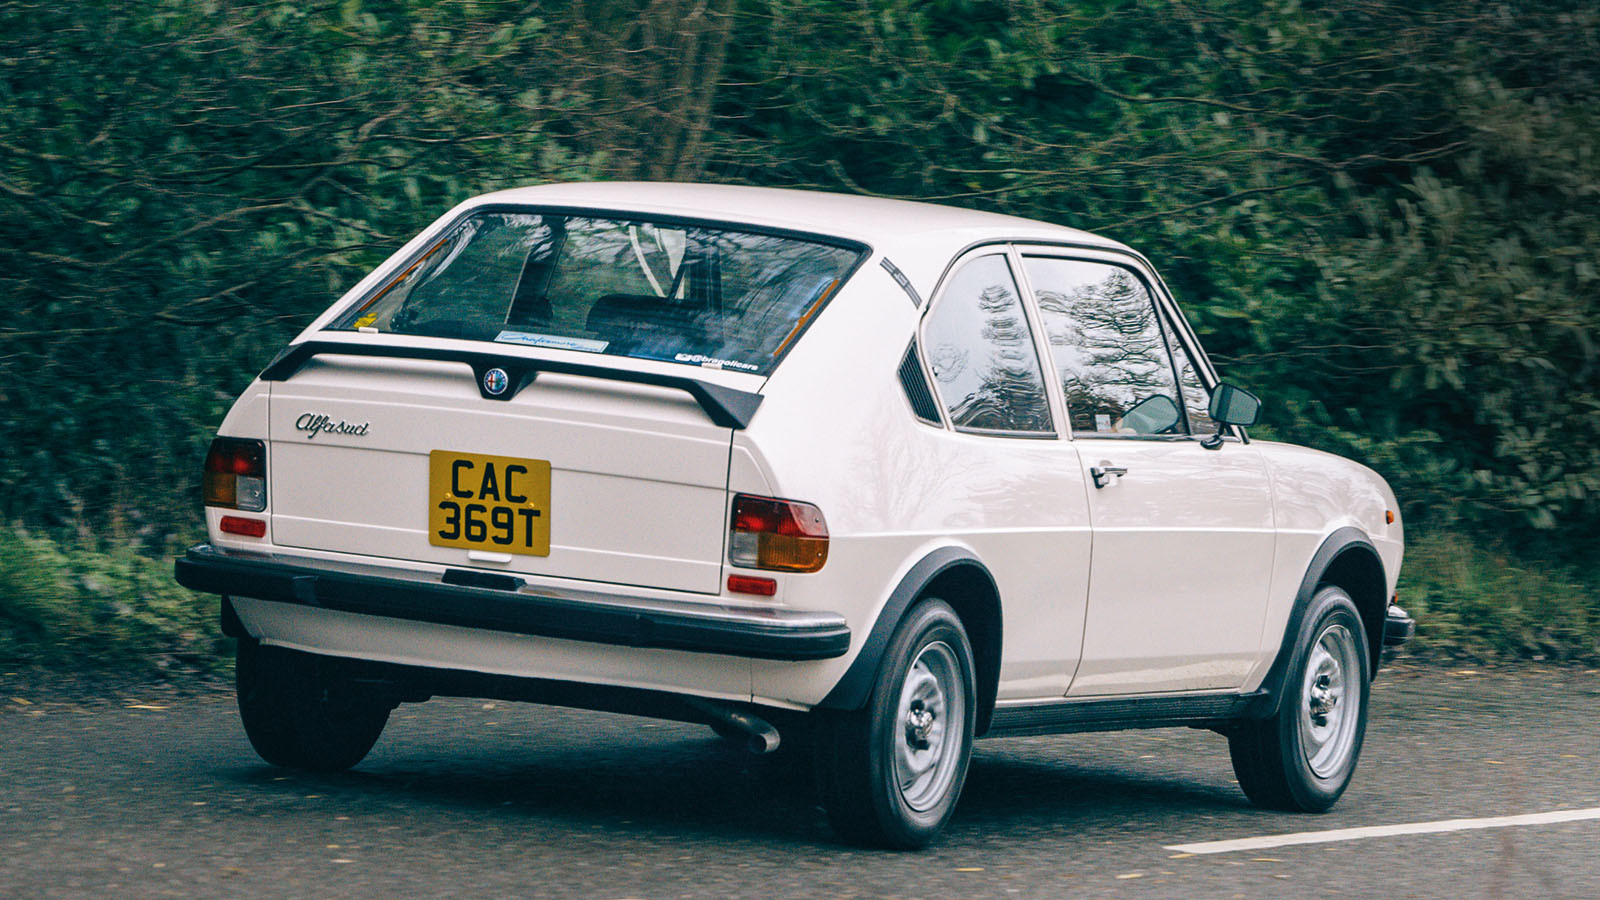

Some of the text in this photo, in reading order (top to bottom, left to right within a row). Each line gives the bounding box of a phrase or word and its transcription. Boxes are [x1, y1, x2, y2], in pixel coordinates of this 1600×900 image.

[295, 412, 370, 439] Alfasud
[451, 459, 528, 504] CAC
[438, 500, 541, 548] 369T
